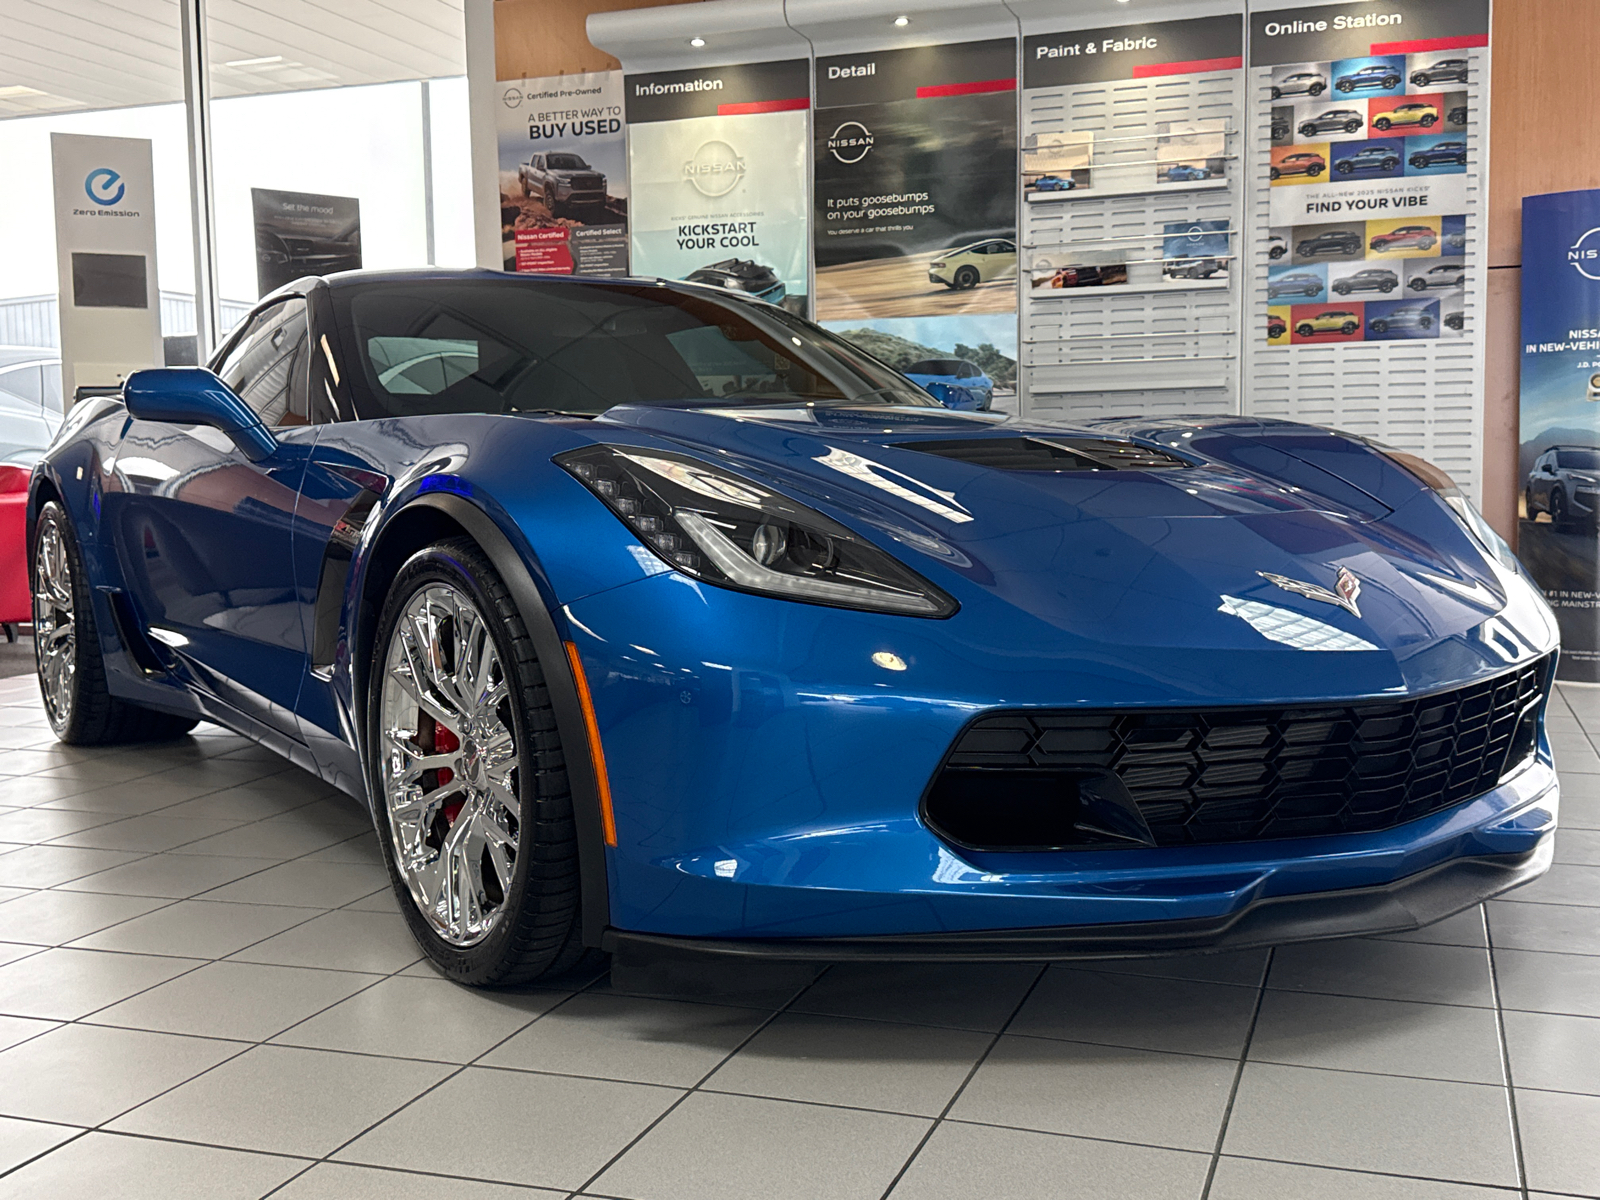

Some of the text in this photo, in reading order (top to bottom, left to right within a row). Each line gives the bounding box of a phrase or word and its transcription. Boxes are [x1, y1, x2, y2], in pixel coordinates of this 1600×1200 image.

[1265, 13, 1402, 36] Online Station
[1036, 36, 1157, 60] Paint & Fabric
[828, 63, 876, 79] Detail
[527, 87, 602, 100] Certified Pre-Owned
[635, 78, 723, 96] Information
[528, 106, 621, 123] A BETTER WAY TO
[529, 118, 621, 140] BUY USED
[828, 137, 874, 148] NISSAN
[684, 160, 746, 175] NISSAN
[282, 202, 334, 215] Set the mood
[827, 192, 929, 209] It puts goosebumps
[1306, 195, 1428, 214] FIND YOUR VIBE
[827, 204, 935, 221] on your goosebumps
[517, 231, 564, 241] Nissan Certified
[576, 229, 602, 237] Certified
[678, 221, 757, 237] KICKSTART
[676, 235, 759, 250] YOUR COOL
[1526, 344, 1537, 353] IN
[1559, 590, 1569, 598] IN
